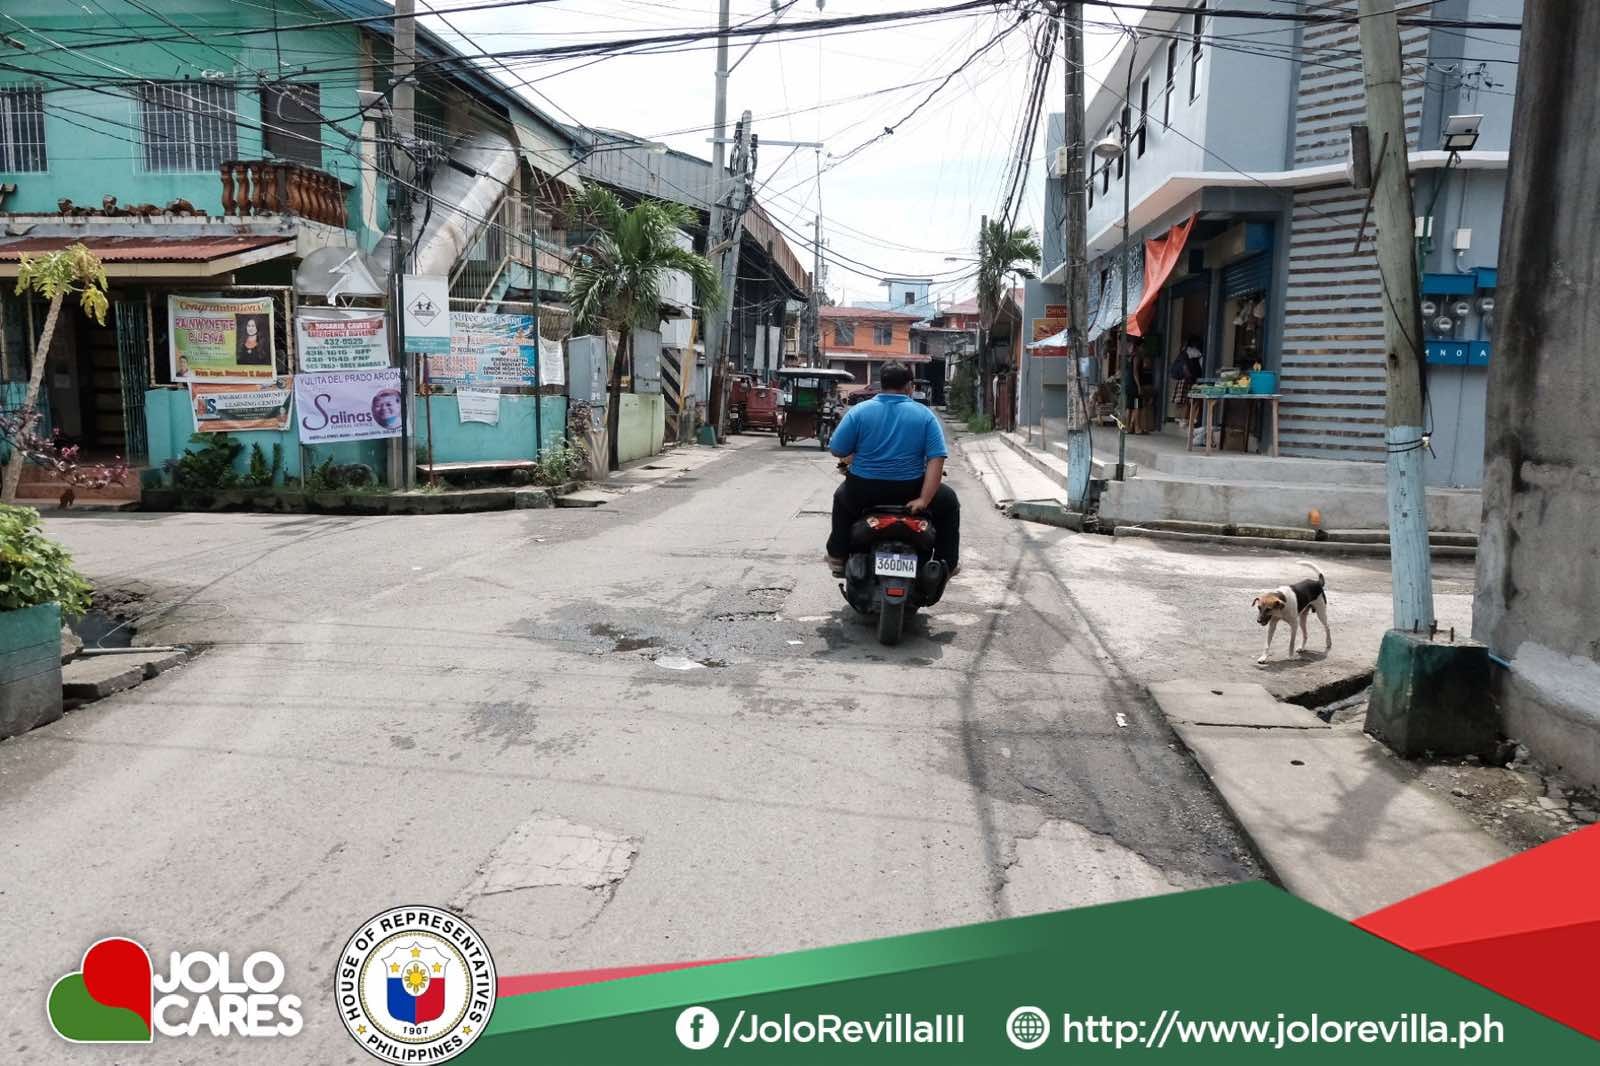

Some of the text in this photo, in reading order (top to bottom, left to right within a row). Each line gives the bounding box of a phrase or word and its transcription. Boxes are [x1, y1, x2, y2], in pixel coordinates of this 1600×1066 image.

[328, 375, 341, 384] DEL
[344, 373, 373, 383] PRADO
[302, 393, 373, 431] Salinas
